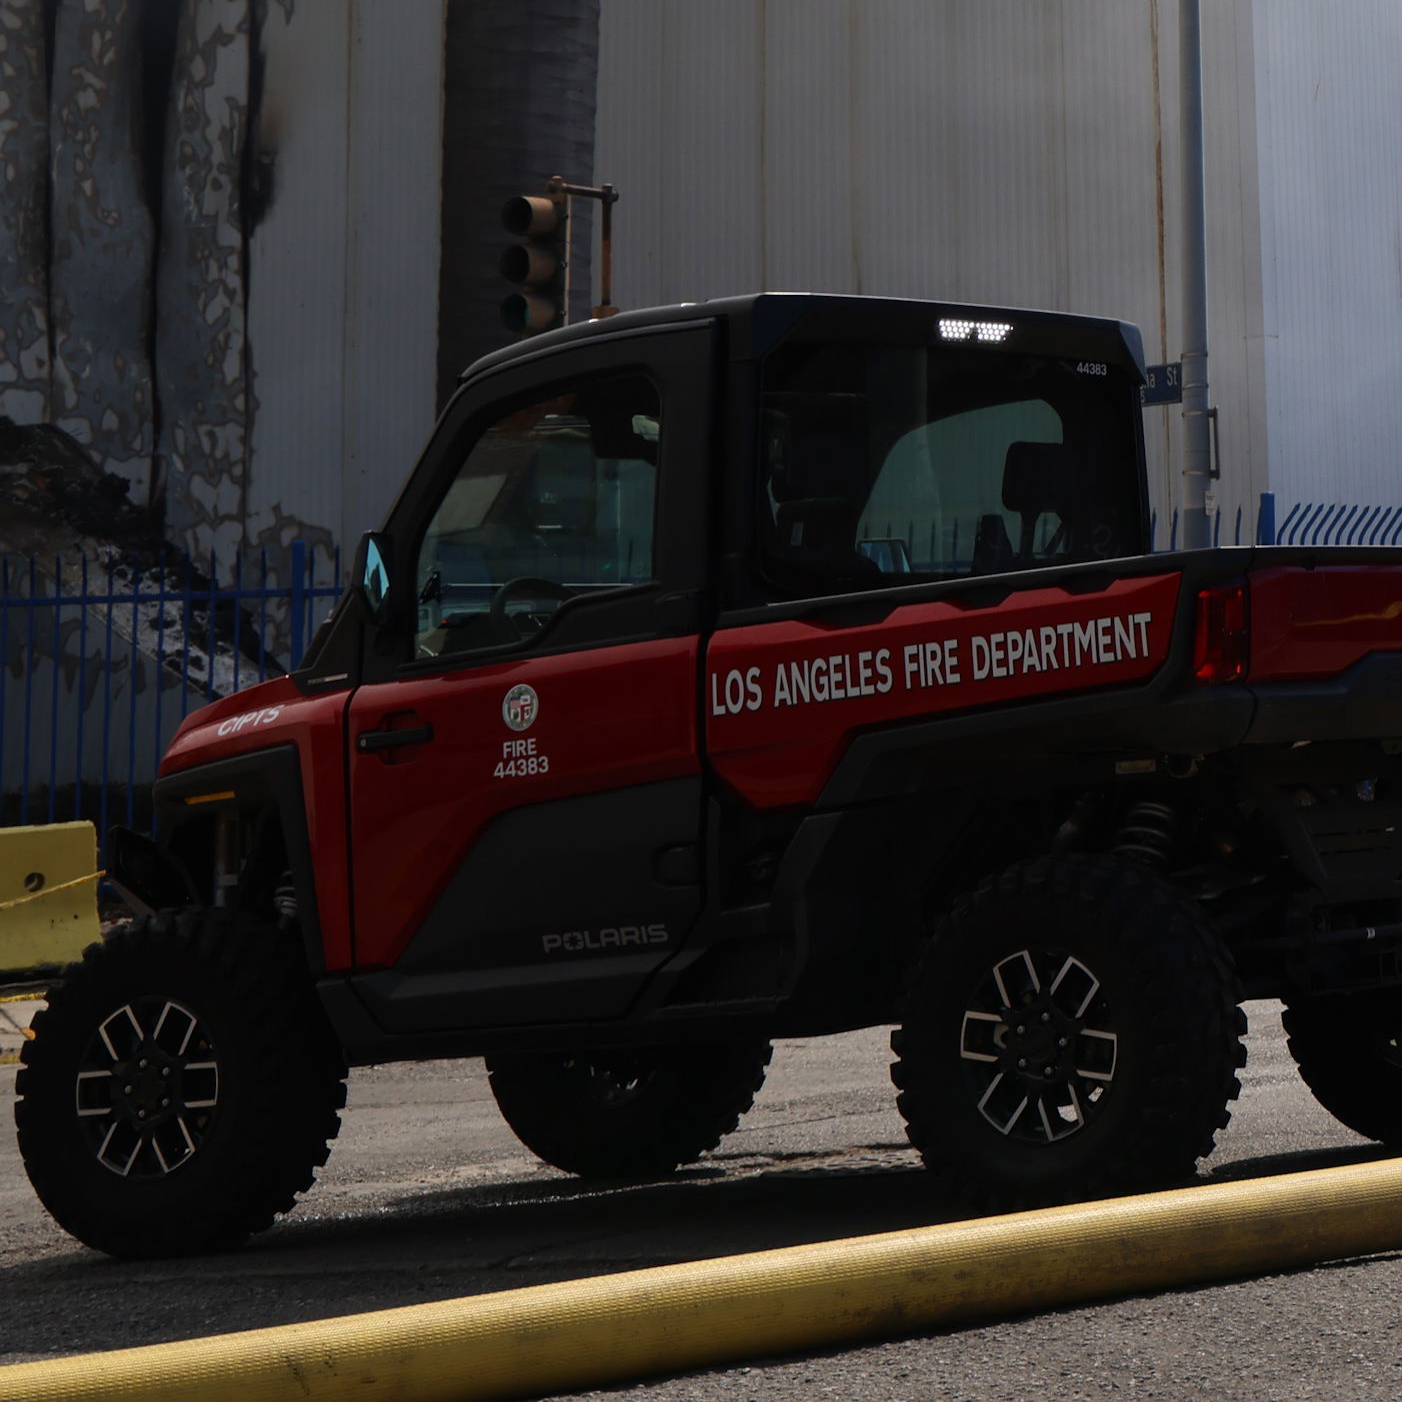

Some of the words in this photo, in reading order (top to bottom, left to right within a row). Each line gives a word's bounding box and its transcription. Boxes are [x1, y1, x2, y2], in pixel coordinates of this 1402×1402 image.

[1076, 361, 1107, 376] 44383
[712, 666, 763, 716] LOS
[774, 648, 893, 707] ANGELES
[903, 639, 961, 689] FIRE
[971, 612, 1152, 681] DEPARTMENT
[217, 704, 285, 737] CIPTS
[503, 738, 537, 759] FIRE
[493, 756, 549, 779] 44383
[542, 923, 669, 953] POLARIS
